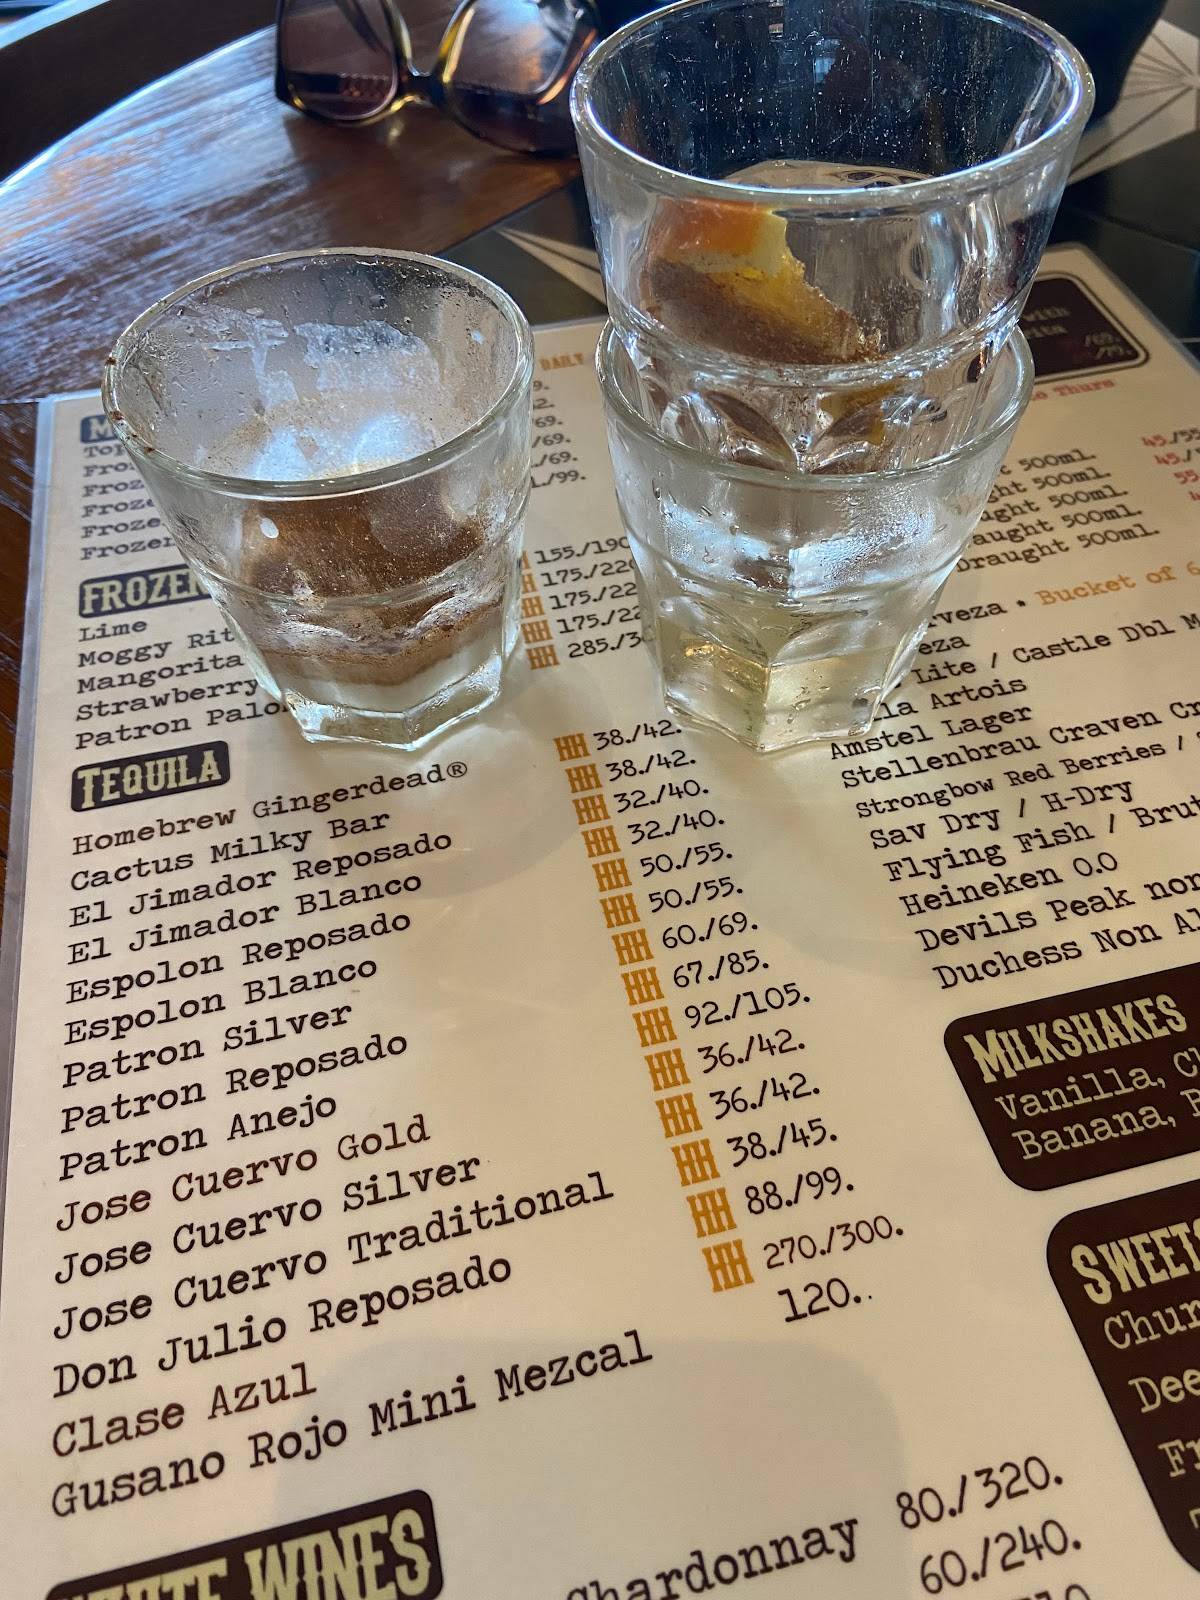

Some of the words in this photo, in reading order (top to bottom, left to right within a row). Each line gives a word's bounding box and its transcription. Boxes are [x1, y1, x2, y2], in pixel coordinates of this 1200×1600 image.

[538, 353, 585, 371] DAILY
[1019, 449, 1097, 472] 500ml.
[1034, 467, 1112, 490] 500ml.
[1048, 485, 1129, 509] 500ml.
[1061, 504, 1143, 529] 500ml.
[956, 539, 1070, 573] Draught
[1077, 524, 1160, 549] 500ml.
[1035, 574, 1137, 606] Bucket
[1146, 565, 1176, 583] of
[77, 641, 172, 668] Moggy
[78, 621, 147, 642] Lime
[526, 644, 560, 670] HH
[911, 661, 976, 684] Lite
[1013, 634, 1111, 663] Castle
[1118, 619, 1176, 642] Dbl
[75, 678, 259, 722] Strawberry
[77, 654, 245, 694] Mangorita
[931, 678, 1027, 709] Artois
[75, 717, 191, 750] Patron
[206, 701, 290, 726] Palo
[554, 733, 591, 761] HH
[593, 719, 682, 750] 38./42.
[830, 725, 934, 760] Amstel
[941, 704, 1033, 737] Lager
[841, 736, 1041, 790] Stellenbrau
[1049, 710, 1162, 745] Craven
[77, 750, 222, 809] TEQUILA
[565, 763, 603, 794] HH
[605, 750, 696, 782] 38./42.
[572, 794, 611, 825] HH
[613, 779, 709, 813] 32./40.
[855, 777, 995, 819] Strongbow
[1003, 763, 1055, 787] Red
[1059, 740, 1168, 775] Berries
[72, 808, 236, 855] Homebrew
[253, 761, 468, 818] Gingerdead®
[581, 825, 621, 858] HH
[627, 810, 725, 845] 32./40.
[869, 822, 927, 849] Sav
[939, 808, 1001, 834] Dry
[1041, 780, 1134, 813] H-Dry
[69, 901, 113, 928] El
[129, 867, 277, 915] Jimador
[293, 833, 452, 880] Reposado
[71, 849, 194, 891] Cactus
[210, 830, 312, 863] Milky
[328, 811, 390, 839] Bar
[592, 858, 632, 892] HH
[640, 842, 733, 877] 50./55.
[883, 844, 1007, 882] Flying
[1013, 822, 1095, 853] Fish
[899, 867, 1064, 916] Heineken
[1072, 851, 1118, 877] 0.0
[67, 937, 112, 965] El
[129, 903, 279, 952] Jimador
[295, 875, 422, 916] Blanco
[600, 892, 640, 928] HH
[648, 877, 743, 913] 50./55.
[915, 910, 1038, 952] Devils
[1046, 886, 1136, 922] Peak
[66, 954, 224, 1004] Espolon
[241, 911, 411, 965] Reposado
[612, 928, 654, 966] HH
[662, 911, 758, 949] 60./69.
[932, 939, 1083, 990] Duchess
[1091, 922, 1162, 953] Non
[64, 993, 226, 1045] Espolon
[243, 960, 377, 1005] Blanco
[621, 966, 664, 1006] HH
[673, 950, 769, 988] 67./85.
[62, 1038, 205, 1088] Patron
[223, 1005, 352, 1051] Silver
[632, 1006, 678, 1048] HH
[684, 982, 810, 1028] 92./105.
[963, 994, 1188, 1084] MILKSHAKES
[61, 1081, 206, 1134] Patron
[225, 1034, 407, 1095] Reposado
[644, 1047, 691, 1092] HH
[697, 1029, 805, 1073] 36./42.
[655, 1092, 703, 1139] HH
[709, 1072, 820, 1120] 36./42.
[994, 1066, 1167, 1121] Vanilla,
[59, 1128, 208, 1181] Patron
[227, 1094, 337, 1140] Anejo
[671, 1138, 721, 1187] HH
[727, 1118, 837, 1167] 38./45.
[1011, 1104, 1177, 1160] Banana,
[56, 1190, 152, 1232] Jose
[171, 1149, 318, 1201] Cuervo
[337, 1114, 431, 1161] Gold
[686, 1187, 737, 1238] HH
[745, 1166, 854, 1215] 88./99.
[55, 1241, 153, 1283] Jose
[173, 1198, 323, 1254] Cuervo
[342, 1156, 481, 1213] Silver
[53, 1294, 153, 1339] Jose
[174, 1249, 327, 1309] Cuervo
[348, 1171, 614, 1264] Traditional
[702, 1239, 755, 1293] HH
[763, 1215, 904, 1269] 270./300.
[1071, 1218, 1200, 1305] SWEET
[52, 1351, 137, 1399] Don
[157, 1313, 287, 1372] Julio
[308, 1254, 511, 1332] Reposado
[51, 1451, 225, 1518] Gusano
[247, 1415, 347, 1468] Rojo
[369, 1375, 477, 1437] Mini
[495, 1329, 654, 1403] Mezcal
[52, 1401, 185, 1458] Clase
[207, 1362, 318, 1420] Azul
[244, 1508, 432, 1600] WINES
[920, 1519, 1082, 1594] 60./240.
